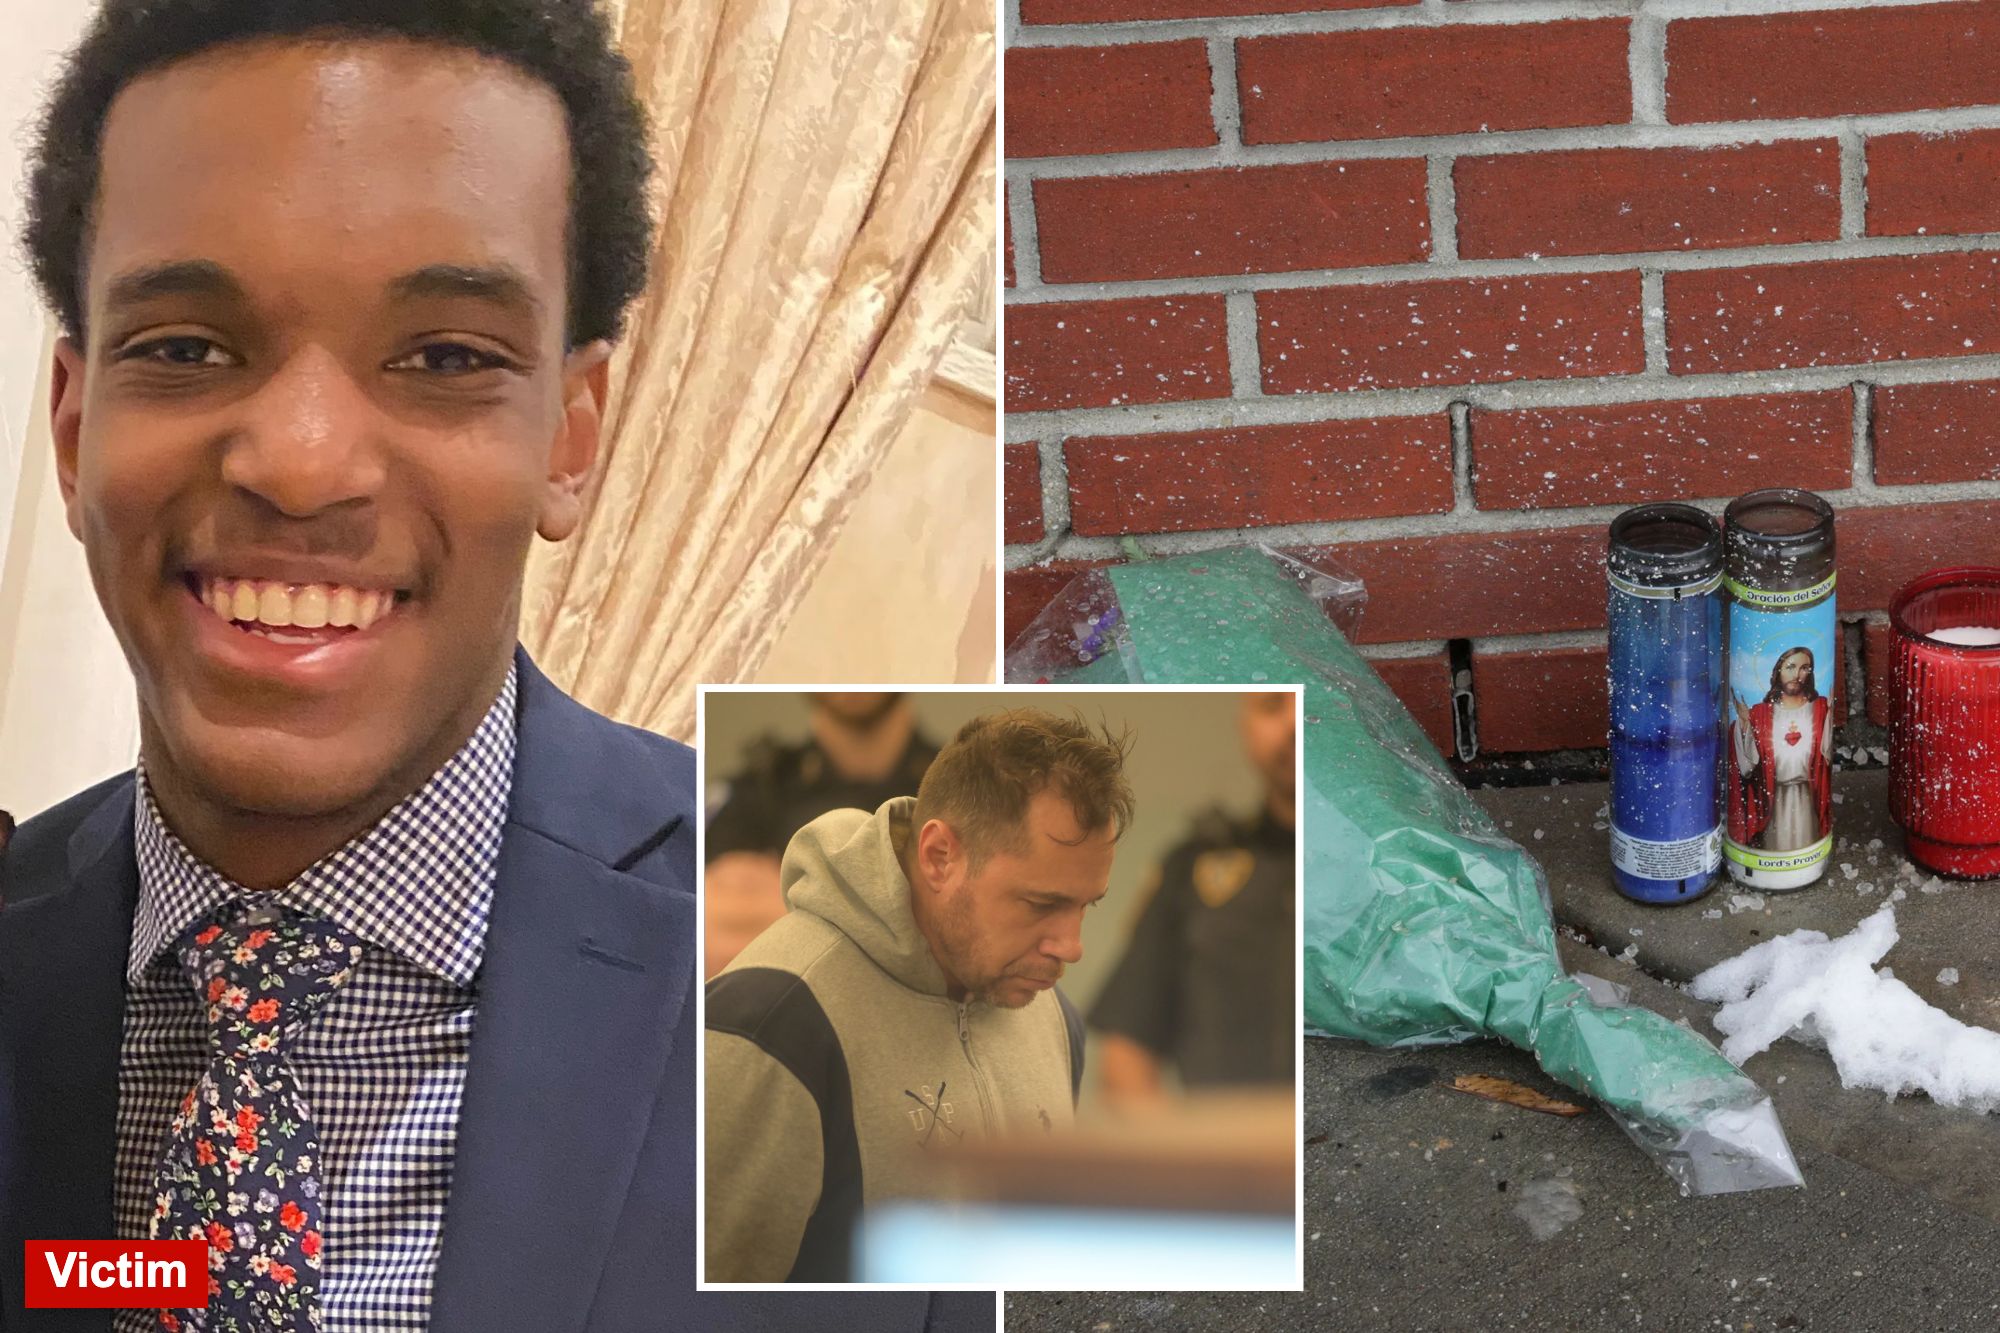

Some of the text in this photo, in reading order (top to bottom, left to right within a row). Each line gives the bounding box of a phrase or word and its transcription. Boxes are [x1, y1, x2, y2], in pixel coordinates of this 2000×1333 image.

[1746, 590, 1791, 603] Oración
[1793, 590, 1809, 602] del
[1758, 851, 1822, 867] Lord's Prayer
